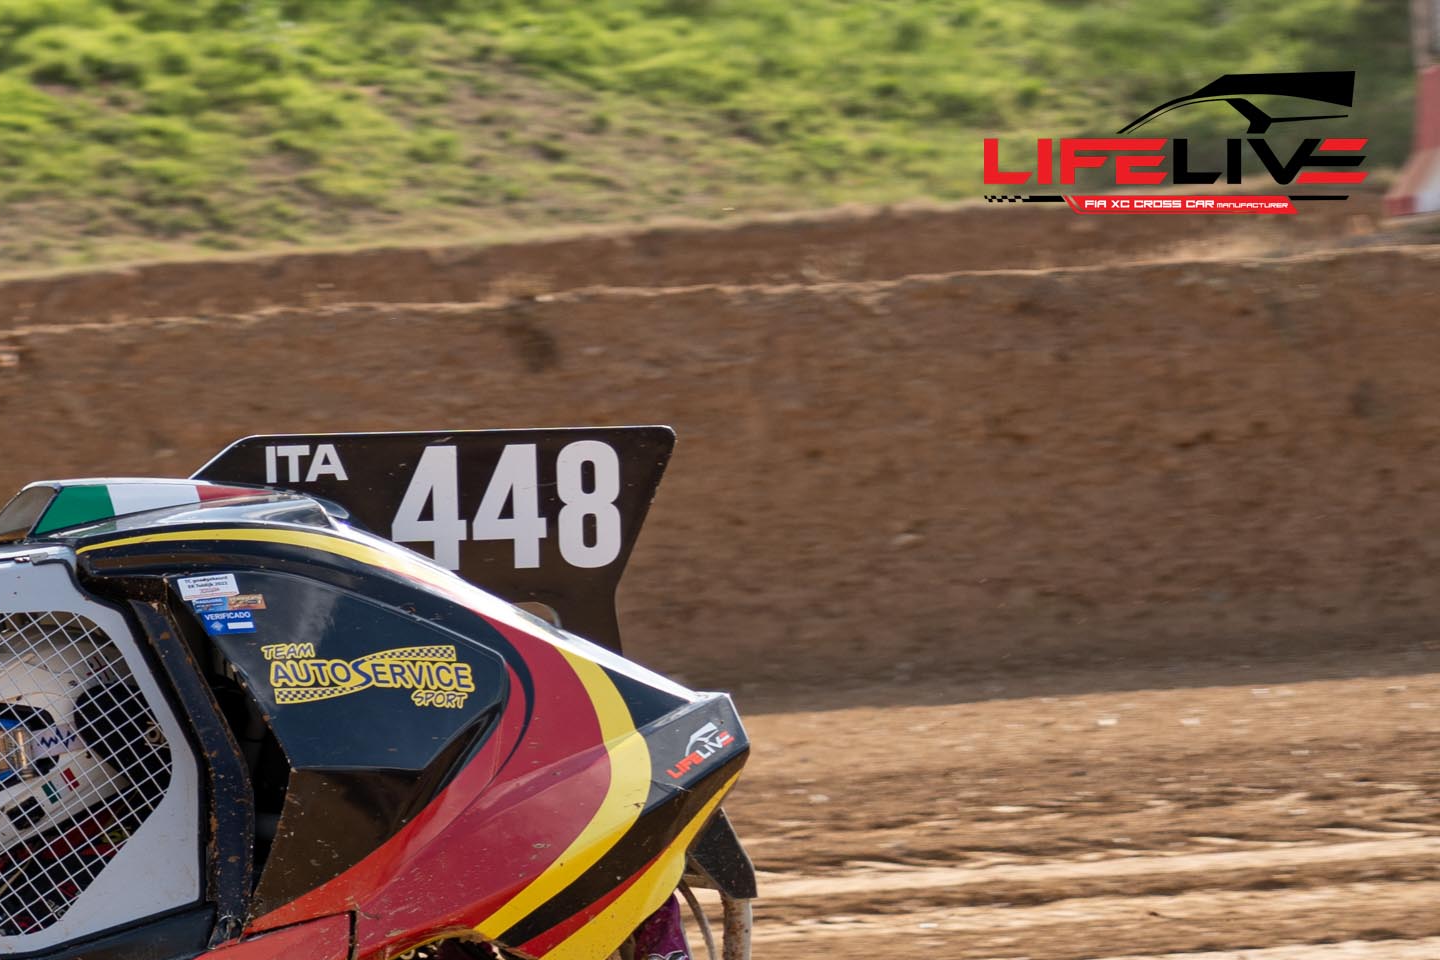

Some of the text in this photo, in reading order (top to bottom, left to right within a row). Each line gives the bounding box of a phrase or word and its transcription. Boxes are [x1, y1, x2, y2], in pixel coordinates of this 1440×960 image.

[265, 443, 349, 484] ITA
[391, 440, 622, 571] 448
[204, 611, 251, 621] VERIFICADO
[262, 643, 315, 660] TEAM
[271, 659, 474, 691] AUTOSERVICE
[411, 691, 468, 708] SPORT
